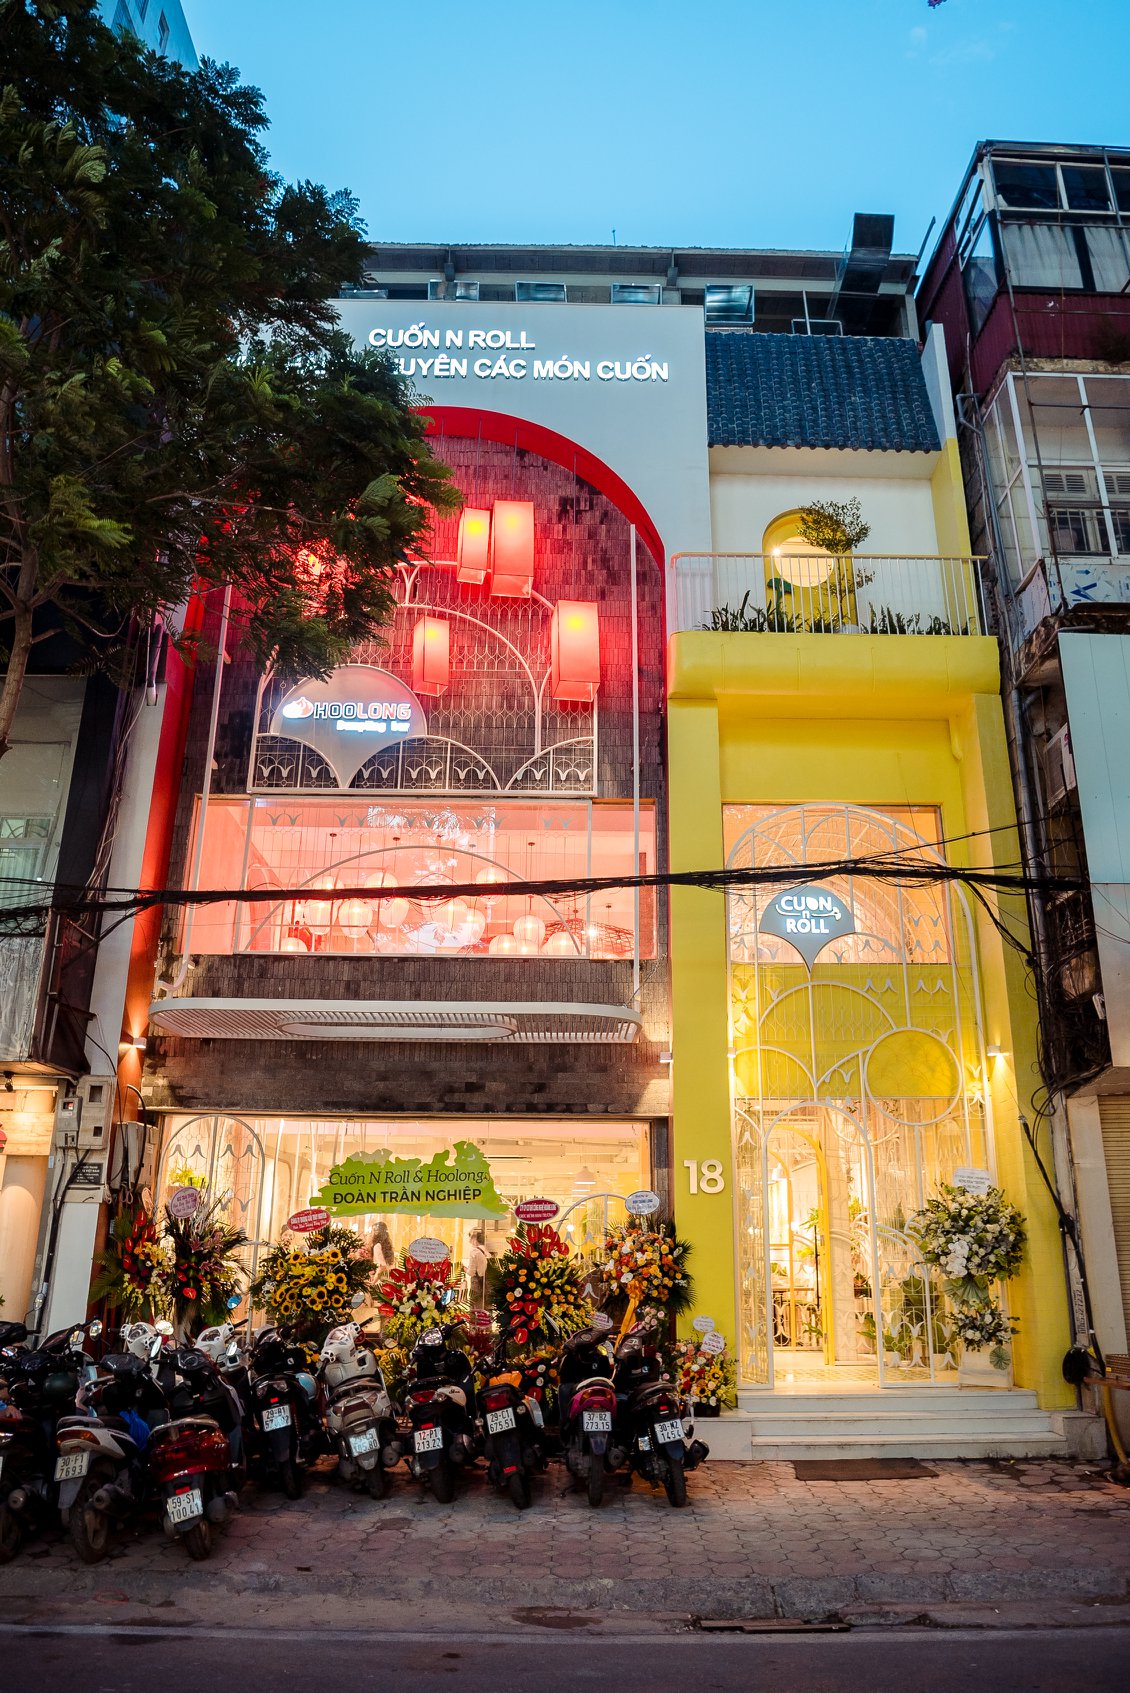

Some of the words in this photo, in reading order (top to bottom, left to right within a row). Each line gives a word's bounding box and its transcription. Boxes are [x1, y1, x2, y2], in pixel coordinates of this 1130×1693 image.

[368, 322, 440, 350] CUỐN
[446, 330, 463, 350] N
[469, 331, 535, 350] ROLL
[474, 355, 527, 380] CÁC
[534, 355, 591, 382] MÓN
[596, 354, 669, 382] CUỐN
[314, 702, 412, 720] HOOLONG
[786, 918, 829, 934] ROLL
[329, 1172, 366, 1186] Cuốn
[369, 1171, 382, 1184] N
[384, 1170, 410, 1184] Roll
[412, 1170, 424, 1184] &
[427, 1168, 484, 1184] Hoolong
[684, 1159, 724, 1195] 18
[333, 1189, 377, 1204] ĐOÀN
[381, 1186, 421, 1203] TRẦN
[425, 1186, 482, 1204] NGHIỆP
[490, 1409, 510, 1422] 29-C1
[490, 1418, 514, 1432] 675.51
[586, 1421, 610, 1430] 273.15
[58, 1465, 83, 1479] 7693
[171, 1492, 195, 1509] 59-S1
